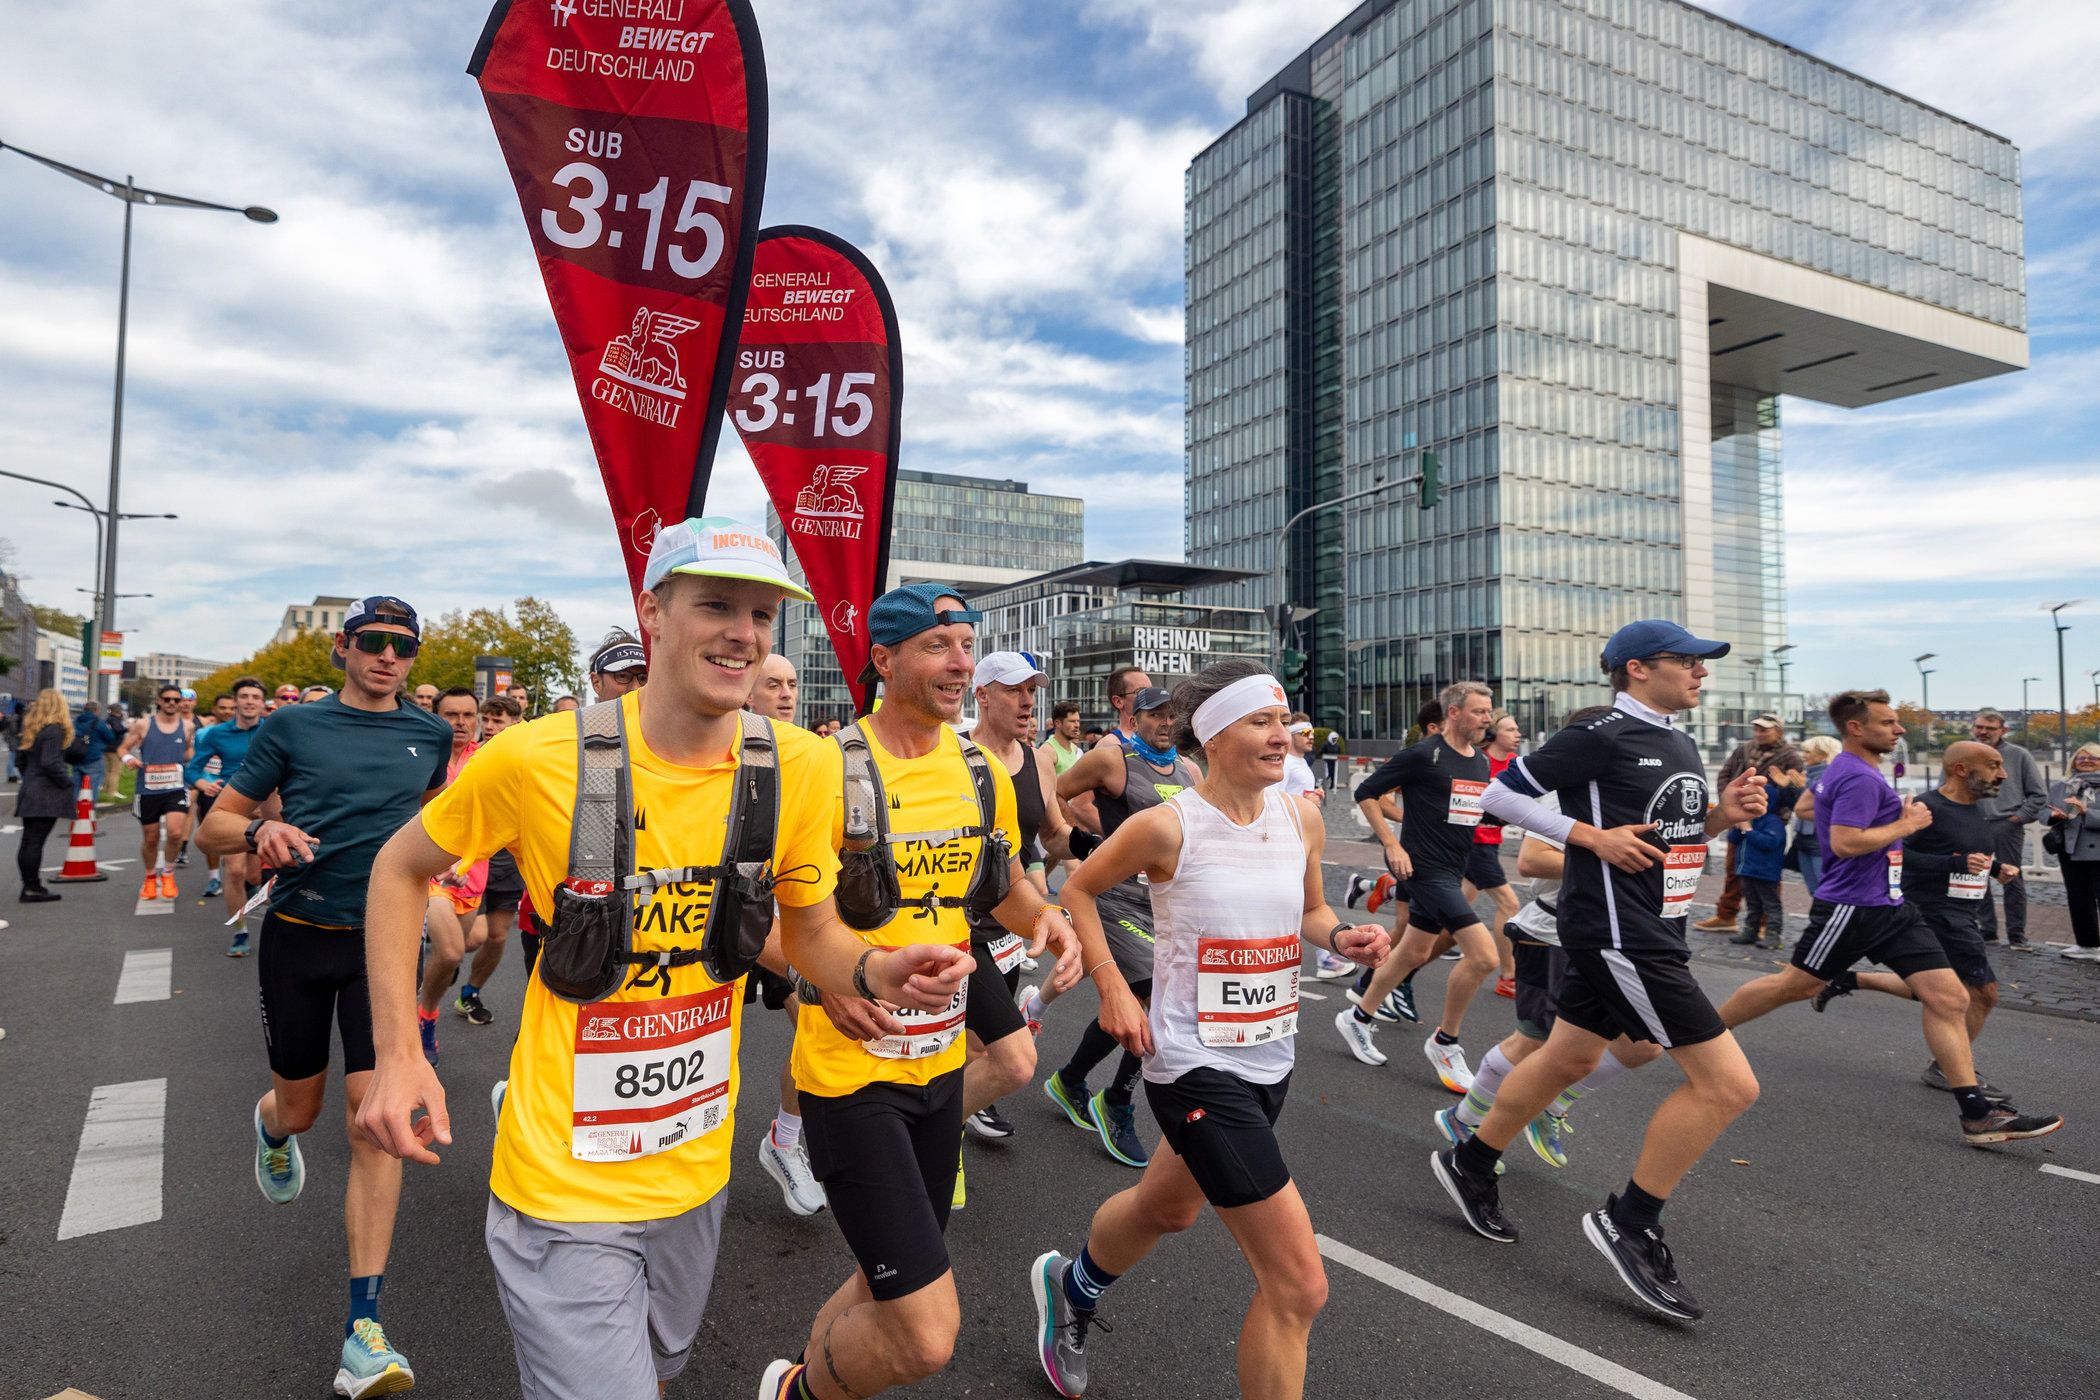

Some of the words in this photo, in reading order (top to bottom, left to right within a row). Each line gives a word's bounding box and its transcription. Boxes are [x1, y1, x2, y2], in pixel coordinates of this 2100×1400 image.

[619, 27, 714, 53] BEWEGT
[546, 48, 695, 82] DEUTSCHLAND
[565, 127, 623, 159] SUB
[541, 161, 732, 279] 3:15
[783, 289, 855, 305] BEWEGT
[743, 307, 844, 323] EUTSCHLAND
[739, 350, 785, 369] SUB
[591, 377, 682, 428] GENERALI
[735, 372, 876, 437] 3:15
[791, 517, 862, 540] GENERALI
[713, 533, 781, 561] INCYLENC
[1134, 627, 1210, 651] RHEINAU
[1134, 652, 1192, 673] HAFEN
[1638, 758, 1662, 766] JAKO
[1452, 797, 1480, 808] Malco
[1118, 919, 1155, 944] DYNA
[1230, 943, 1300, 966] GENERALI
[1222, 981, 1276, 1005] Ewa
[1290, 970, 1298, 999] 6164
[623, 996, 729, 1040] GENERALI
[920, 1043, 940, 1055] PUMA
[614, 1050, 705, 1098] 8502
[597, 1129, 629, 1138] GENERALI
[658, 1128, 684, 1148] PUMA
[587, 1149, 628, 1157] MARATHON
[771, 1149, 798, 1190] BROOKS
[1597, 1209, 1620, 1243] HOKA
